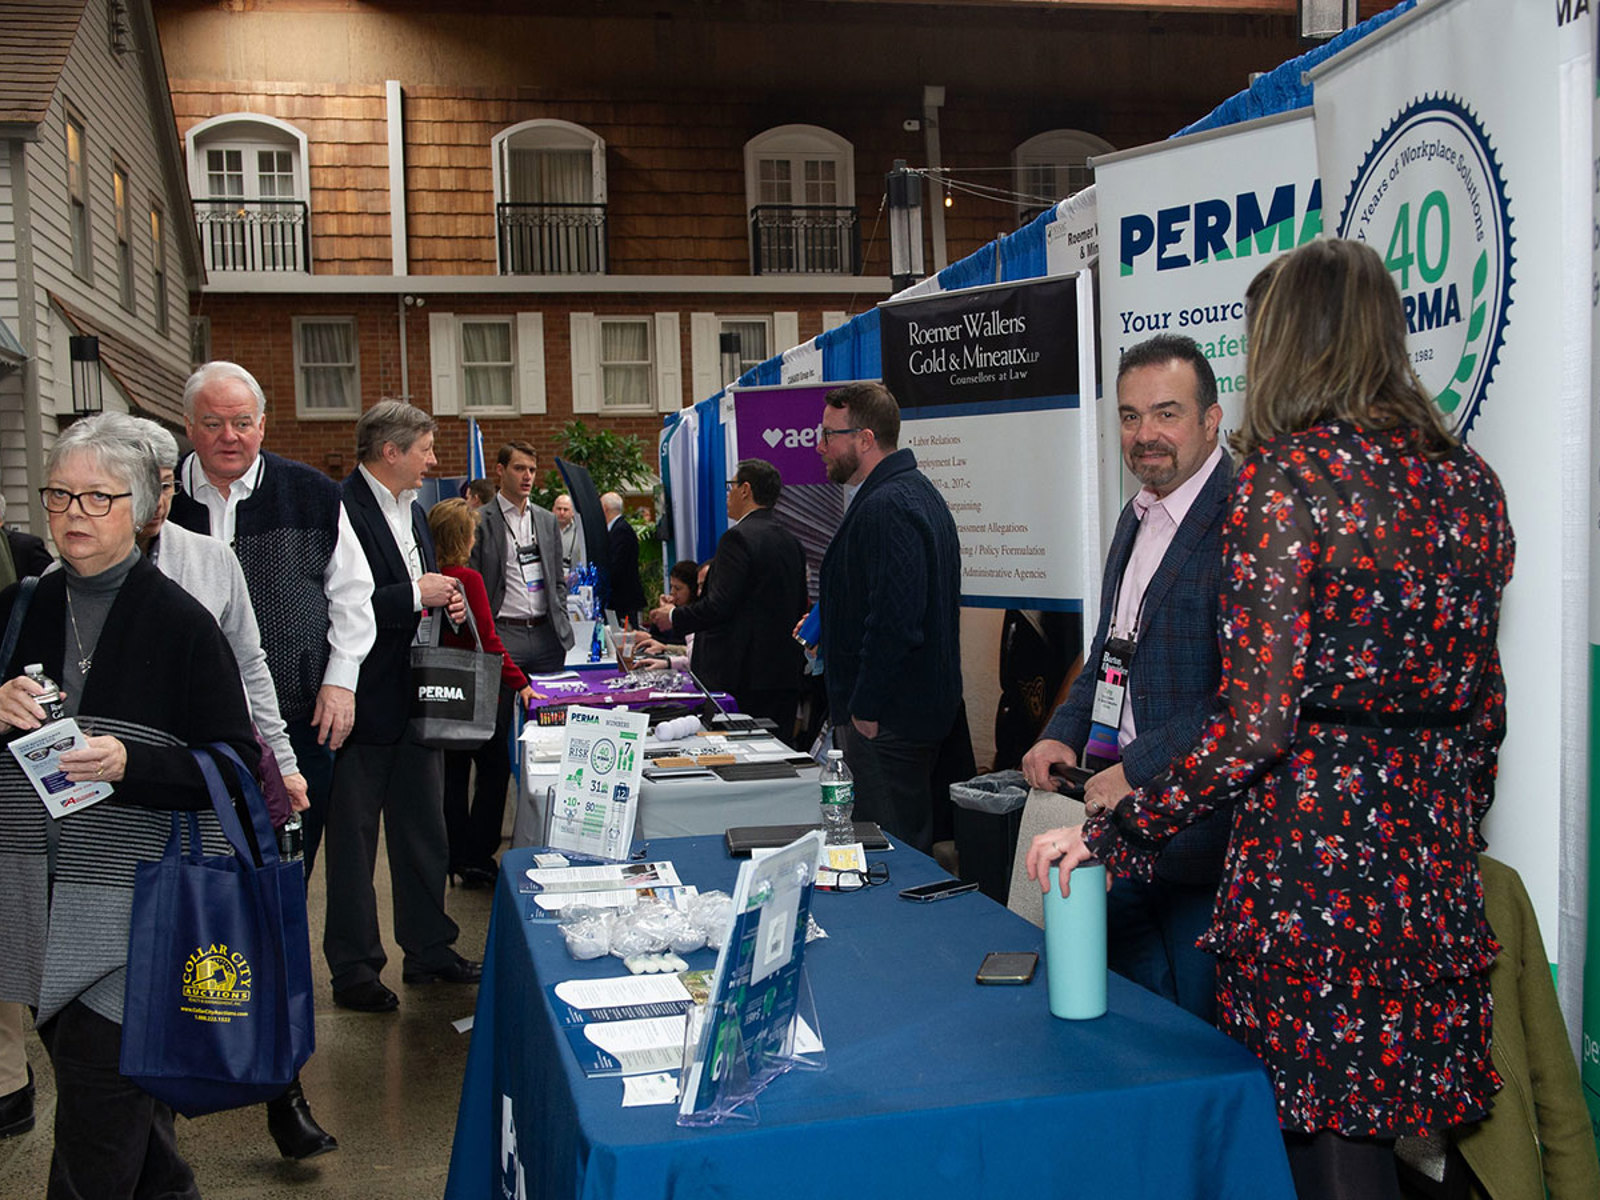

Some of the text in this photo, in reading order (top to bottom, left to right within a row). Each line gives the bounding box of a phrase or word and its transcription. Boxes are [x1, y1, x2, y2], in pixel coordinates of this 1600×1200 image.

[1360, 139, 1485, 242] Years of Workplace Solutions
[1384, 189, 1450, 290] 40
[1120, 301, 1248, 333] Your sourc
[908, 311, 1026, 346] Roemer Wallens
[908, 348, 947, 375] Gold
[949, 353, 961, 371] &
[963, 344, 1027, 370] Mineaux
[1415, 348, 1433, 363] 1982
[950, 368, 1028, 385] Counsellors at Law
[913, 434, 961, 447] Labor Relations
[952, 456, 967, 467] Law
[951, 478, 971, 489] 207-c
[987, 522, 1028, 535] Allegations
[979, 545, 999, 558] Policy
[1001, 545, 1046, 556] Formulation
[962, 567, 1047, 581] Administrative Agencies
[418, 686, 464, 700] PERMA
[571, 712, 600, 724] PERMA
[569, 747, 588, 758] RISK
[600, 747, 609, 756] 40
[625, 742, 631, 755] 7
[590, 780, 601, 793] 31
[617, 789, 626, 798] 12
[567, 797, 577, 807] 10
[585, 801, 595, 812] 80
[183, 944, 252, 988] COLLAR CITY
[186, 988, 248, 999] AUCTIONS
